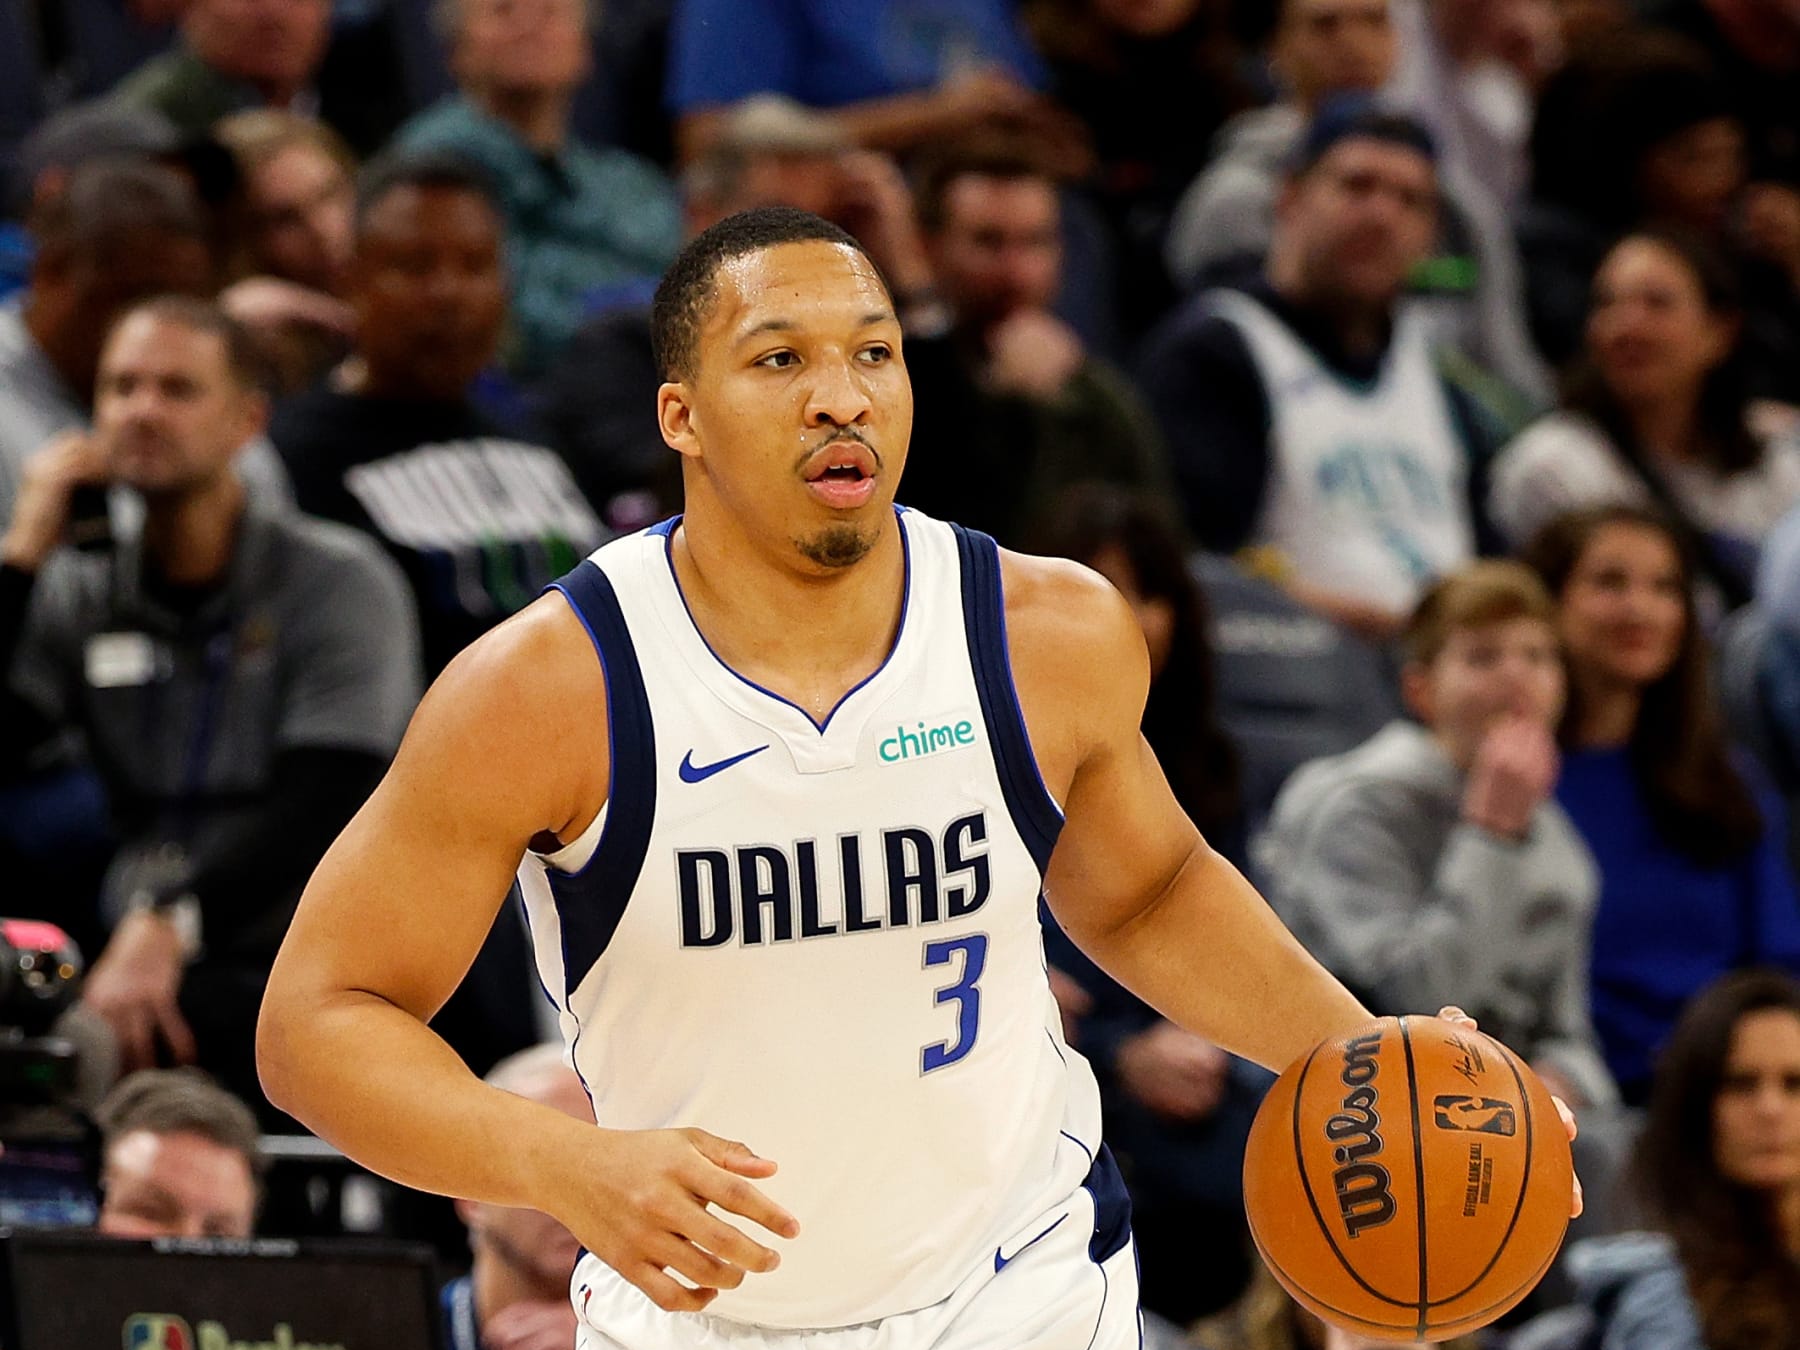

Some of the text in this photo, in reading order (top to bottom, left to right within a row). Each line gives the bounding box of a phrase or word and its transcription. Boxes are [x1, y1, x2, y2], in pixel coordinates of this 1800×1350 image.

[879, 720, 975, 762] chime
[673, 808, 992, 950] DALLAS
[919, 931, 989, 1078] 3
[1325, 1032, 1397, 1239] Wilson
